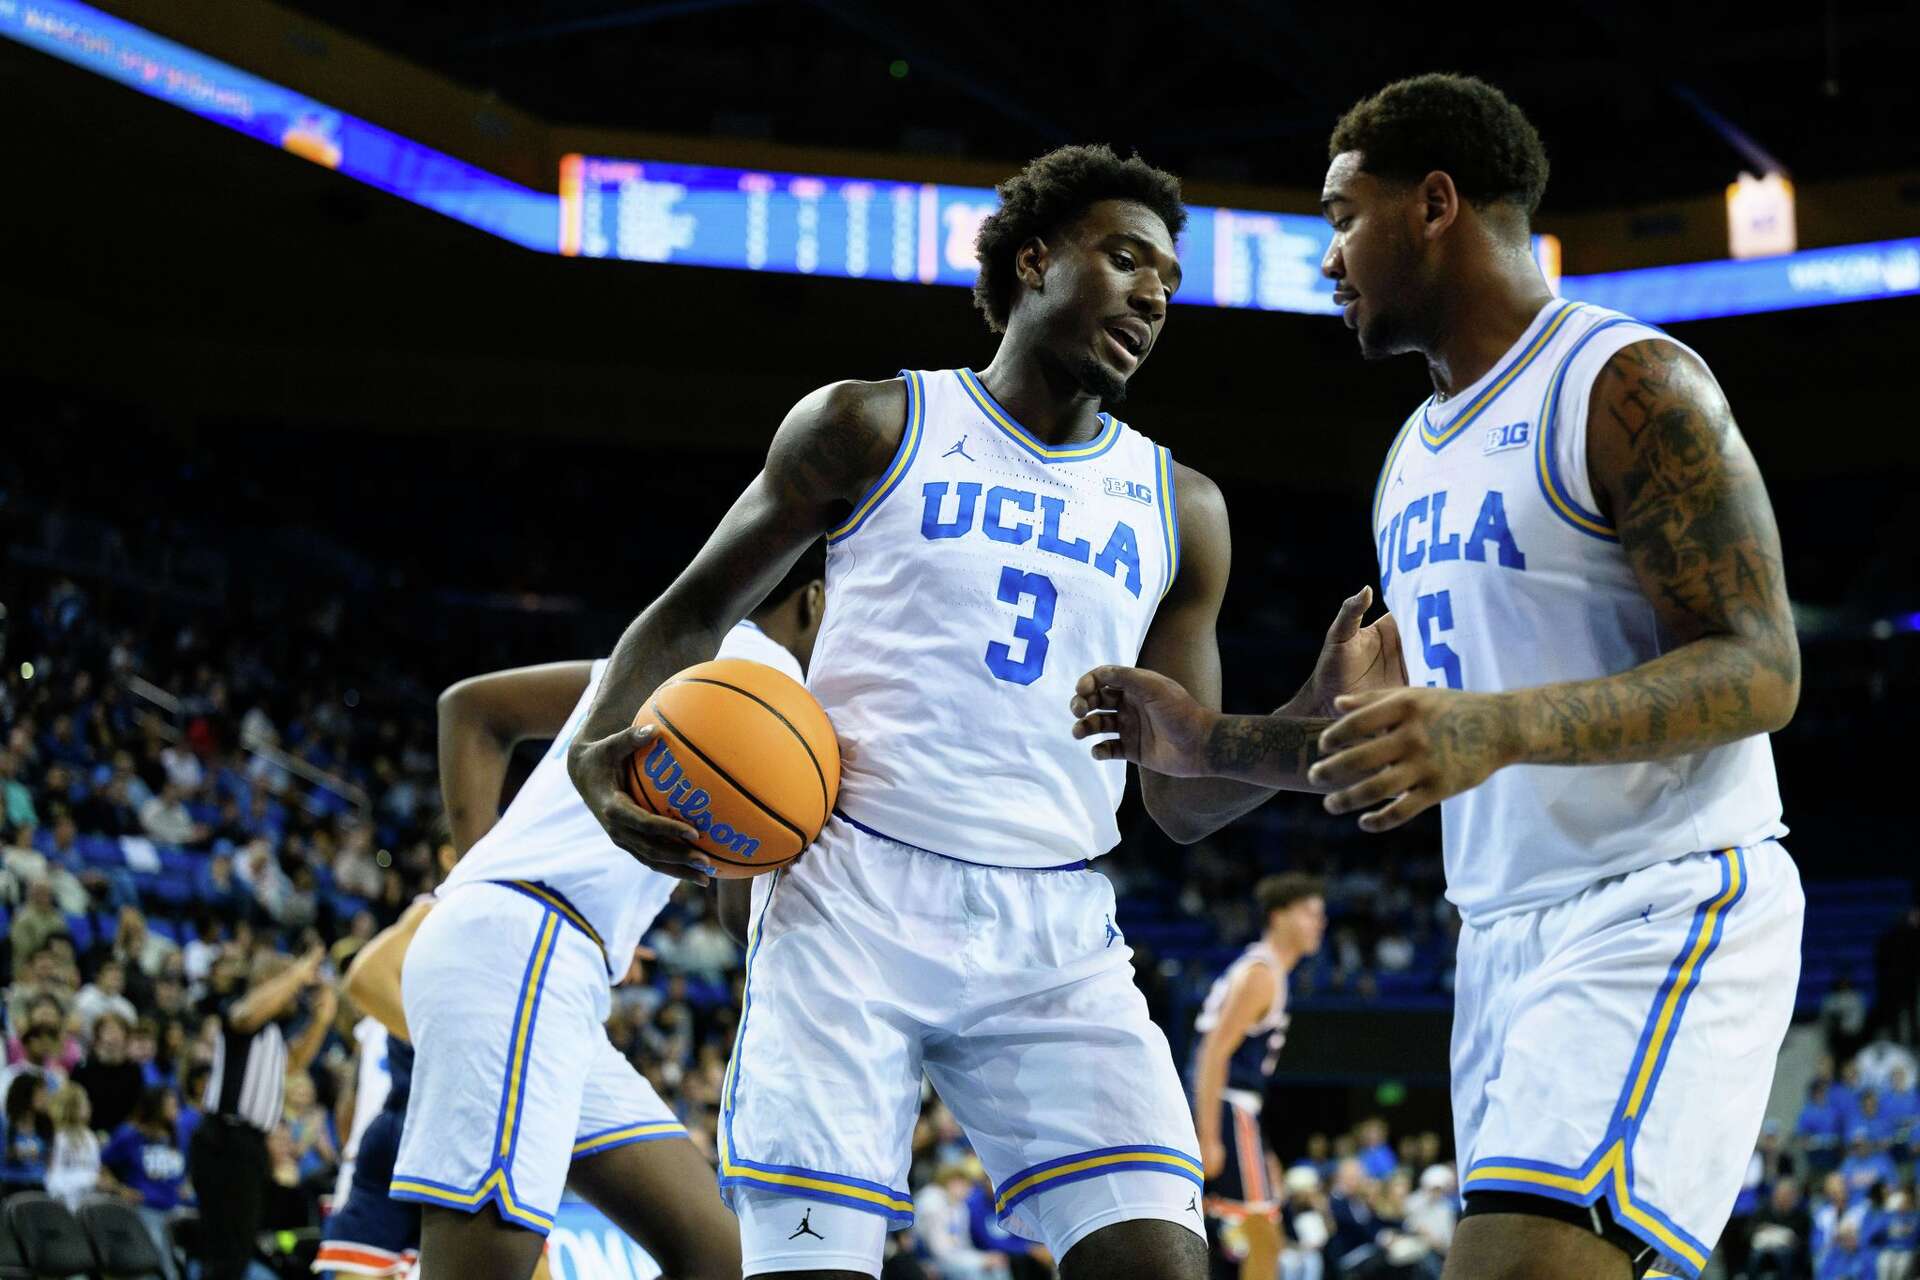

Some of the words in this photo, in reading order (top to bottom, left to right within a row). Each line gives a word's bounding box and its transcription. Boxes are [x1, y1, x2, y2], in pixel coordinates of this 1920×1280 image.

[921, 482, 1142, 600] UCLA
[1379, 490, 1526, 597] UCLA
[985, 566, 1058, 686] 3
[1417, 590, 1463, 690] 5
[644, 736, 761, 858] Wilson
